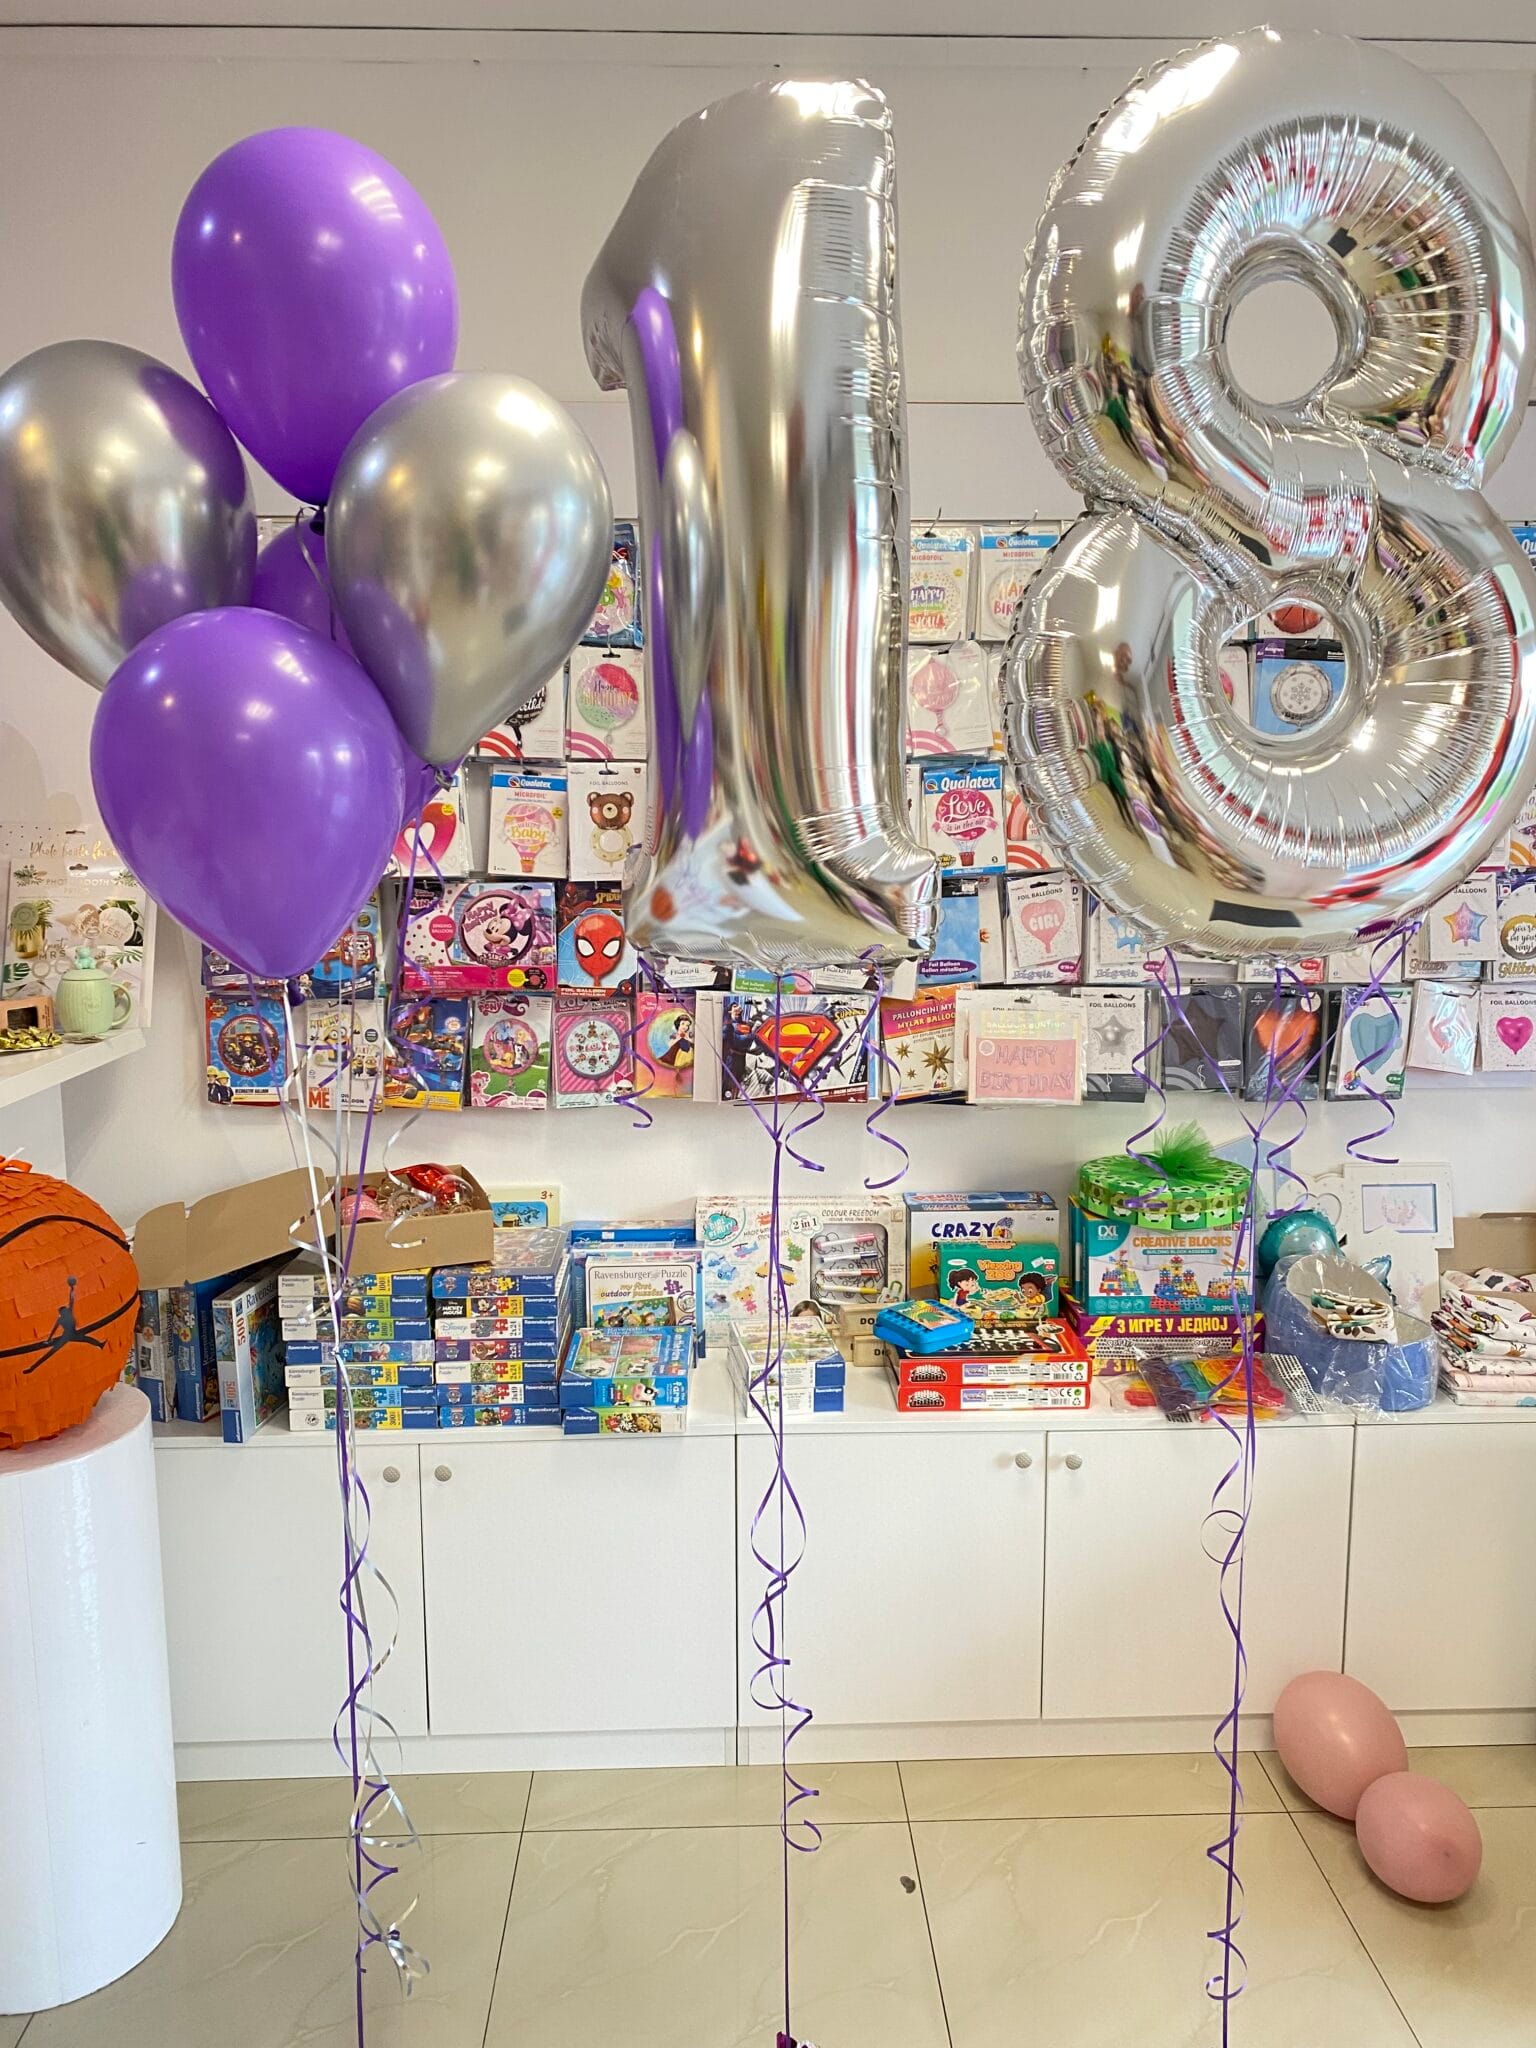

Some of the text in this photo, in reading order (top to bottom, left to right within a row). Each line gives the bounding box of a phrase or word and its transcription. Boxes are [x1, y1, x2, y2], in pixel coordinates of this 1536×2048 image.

[1008, 538, 1038, 548] Qualatex
[941, 776, 996, 791] Qualatex
[943, 794, 986, 823] Love
[1018, 888, 1062, 901] FOIL BALLOONS
[1028, 914, 1060, 932] GIRL
[892, 1007, 929, 1021] PALLONCINI
[898, 1018, 924, 1030] MYLAR
[995, 1044, 1058, 1067] HAPPY
[979, 1071, 1074, 1094] BIRTHDAY
[309, 1091, 330, 1108] ME
[540, 1190, 554, 1200] 3+
[822, 1209, 879, 1217] COLOUR FREEDOM
[792, 1221, 800, 1230] 2
[801, 1219, 810, 1228] in
[931, 1221, 996, 1238] CRAZY
[1132, 1235, 1232, 1248] CREATIVE BLOCKS
[594, 1269, 688, 1281] Ravensburger Puzzle
[600, 1290, 631, 1298] outdoor
[236, 1317, 246, 1346] 500
[1129, 1318, 1163, 1334] ИГРЕ
[1165, 1318, 1174, 1332] У
[1178, 1316, 1229, 1335] ЈЕДНОЈ
